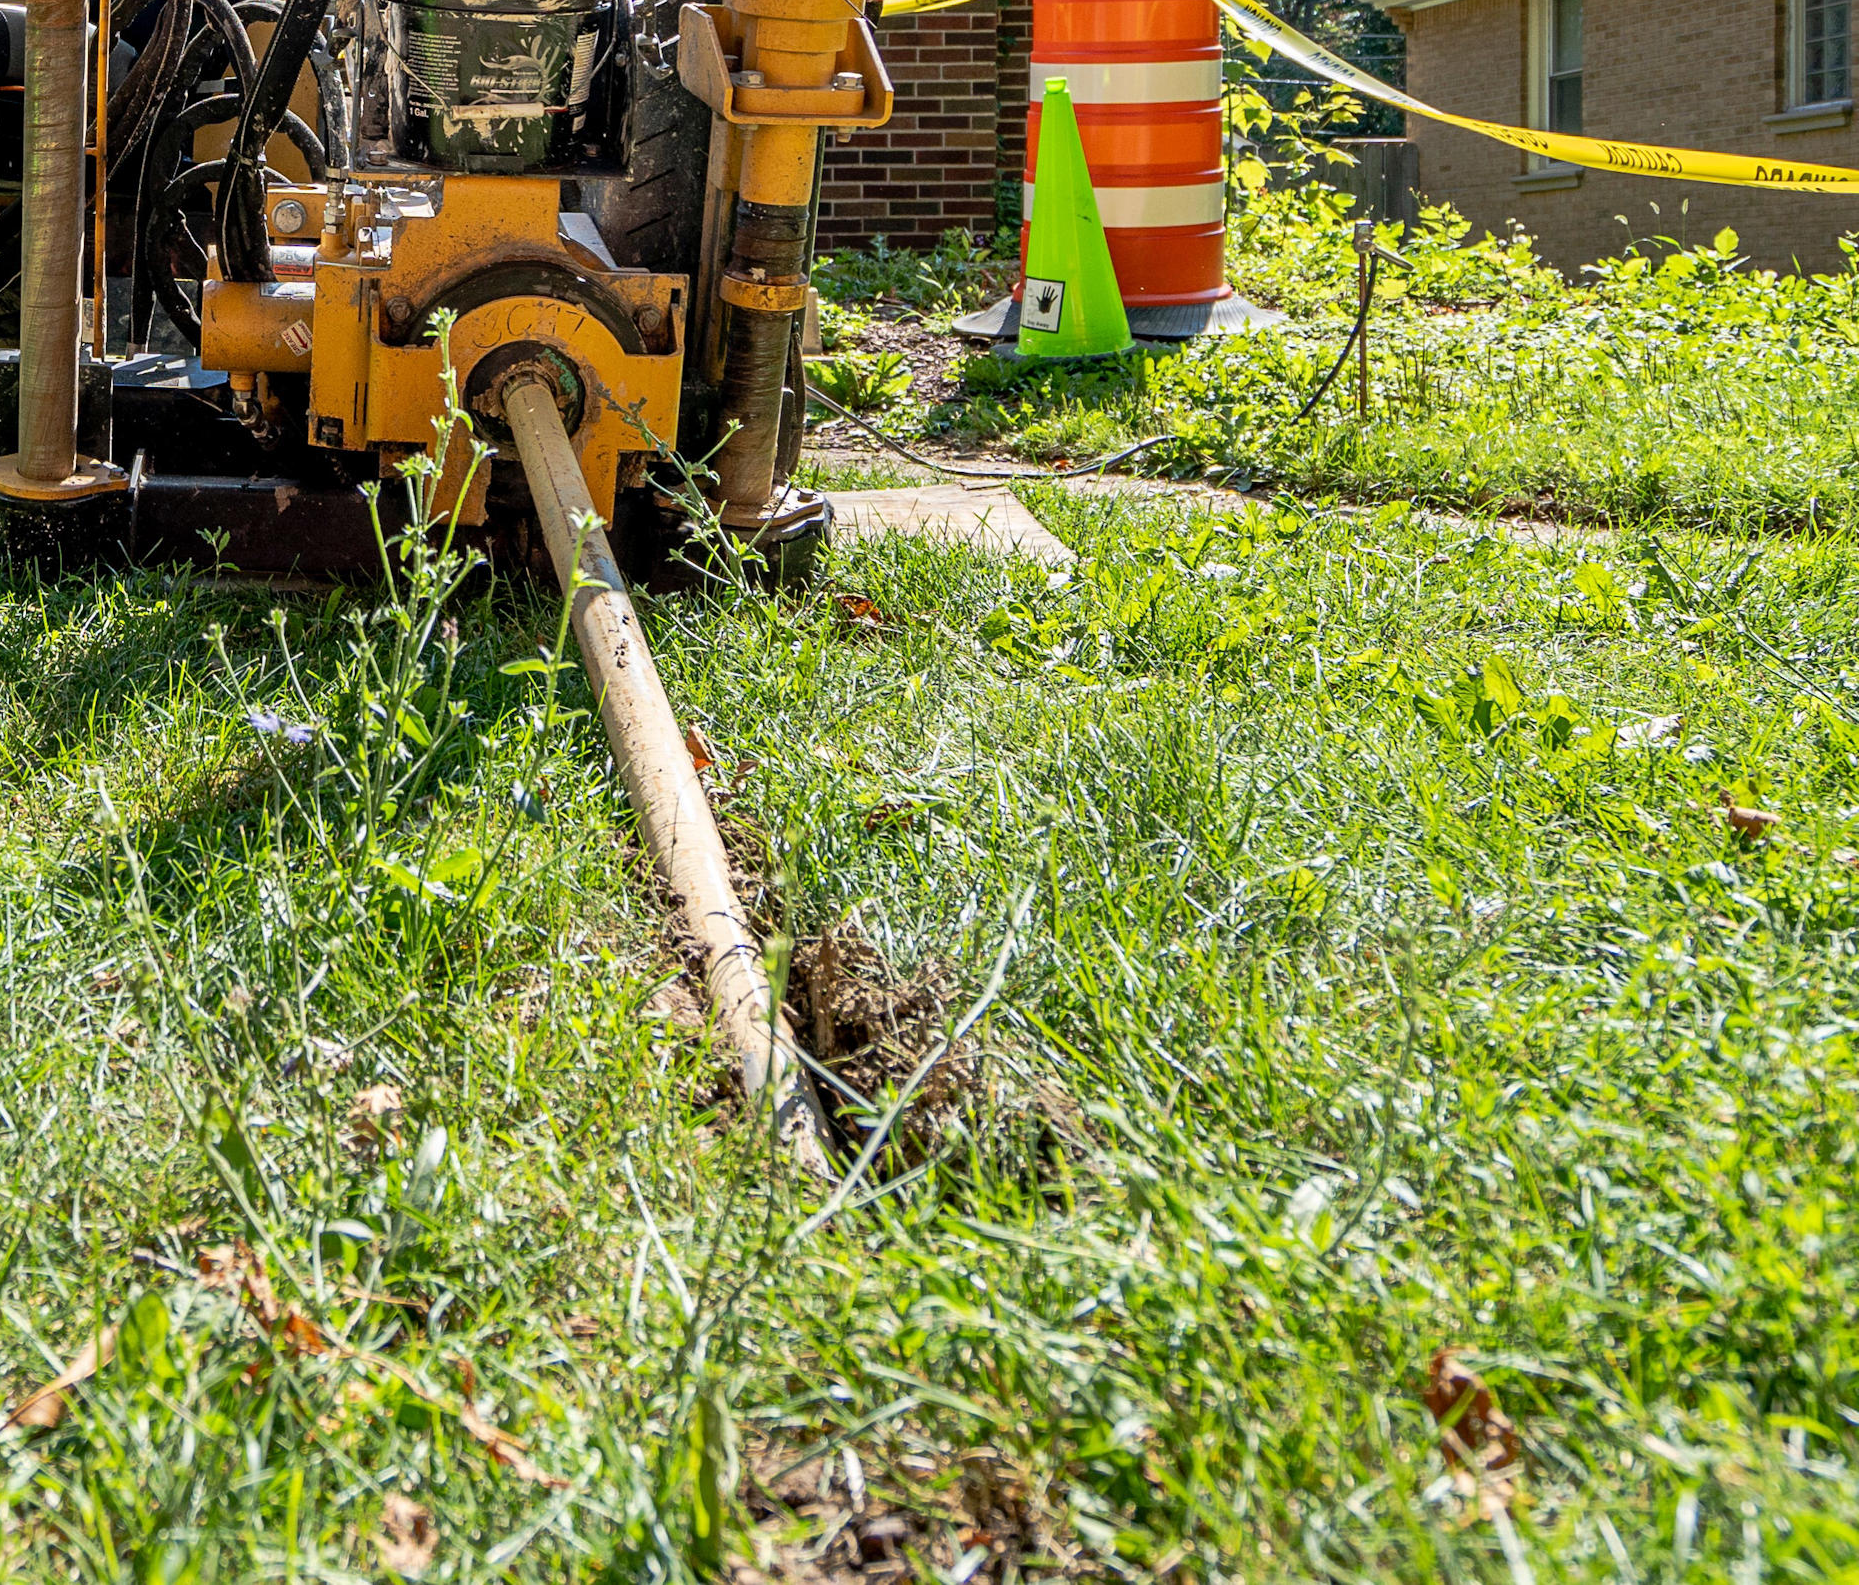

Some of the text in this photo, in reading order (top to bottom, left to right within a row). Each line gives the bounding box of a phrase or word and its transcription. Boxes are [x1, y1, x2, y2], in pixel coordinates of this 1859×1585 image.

[409, 107, 429, 118] 1 Gal.
[283, 333, 302, 355] GREASE
